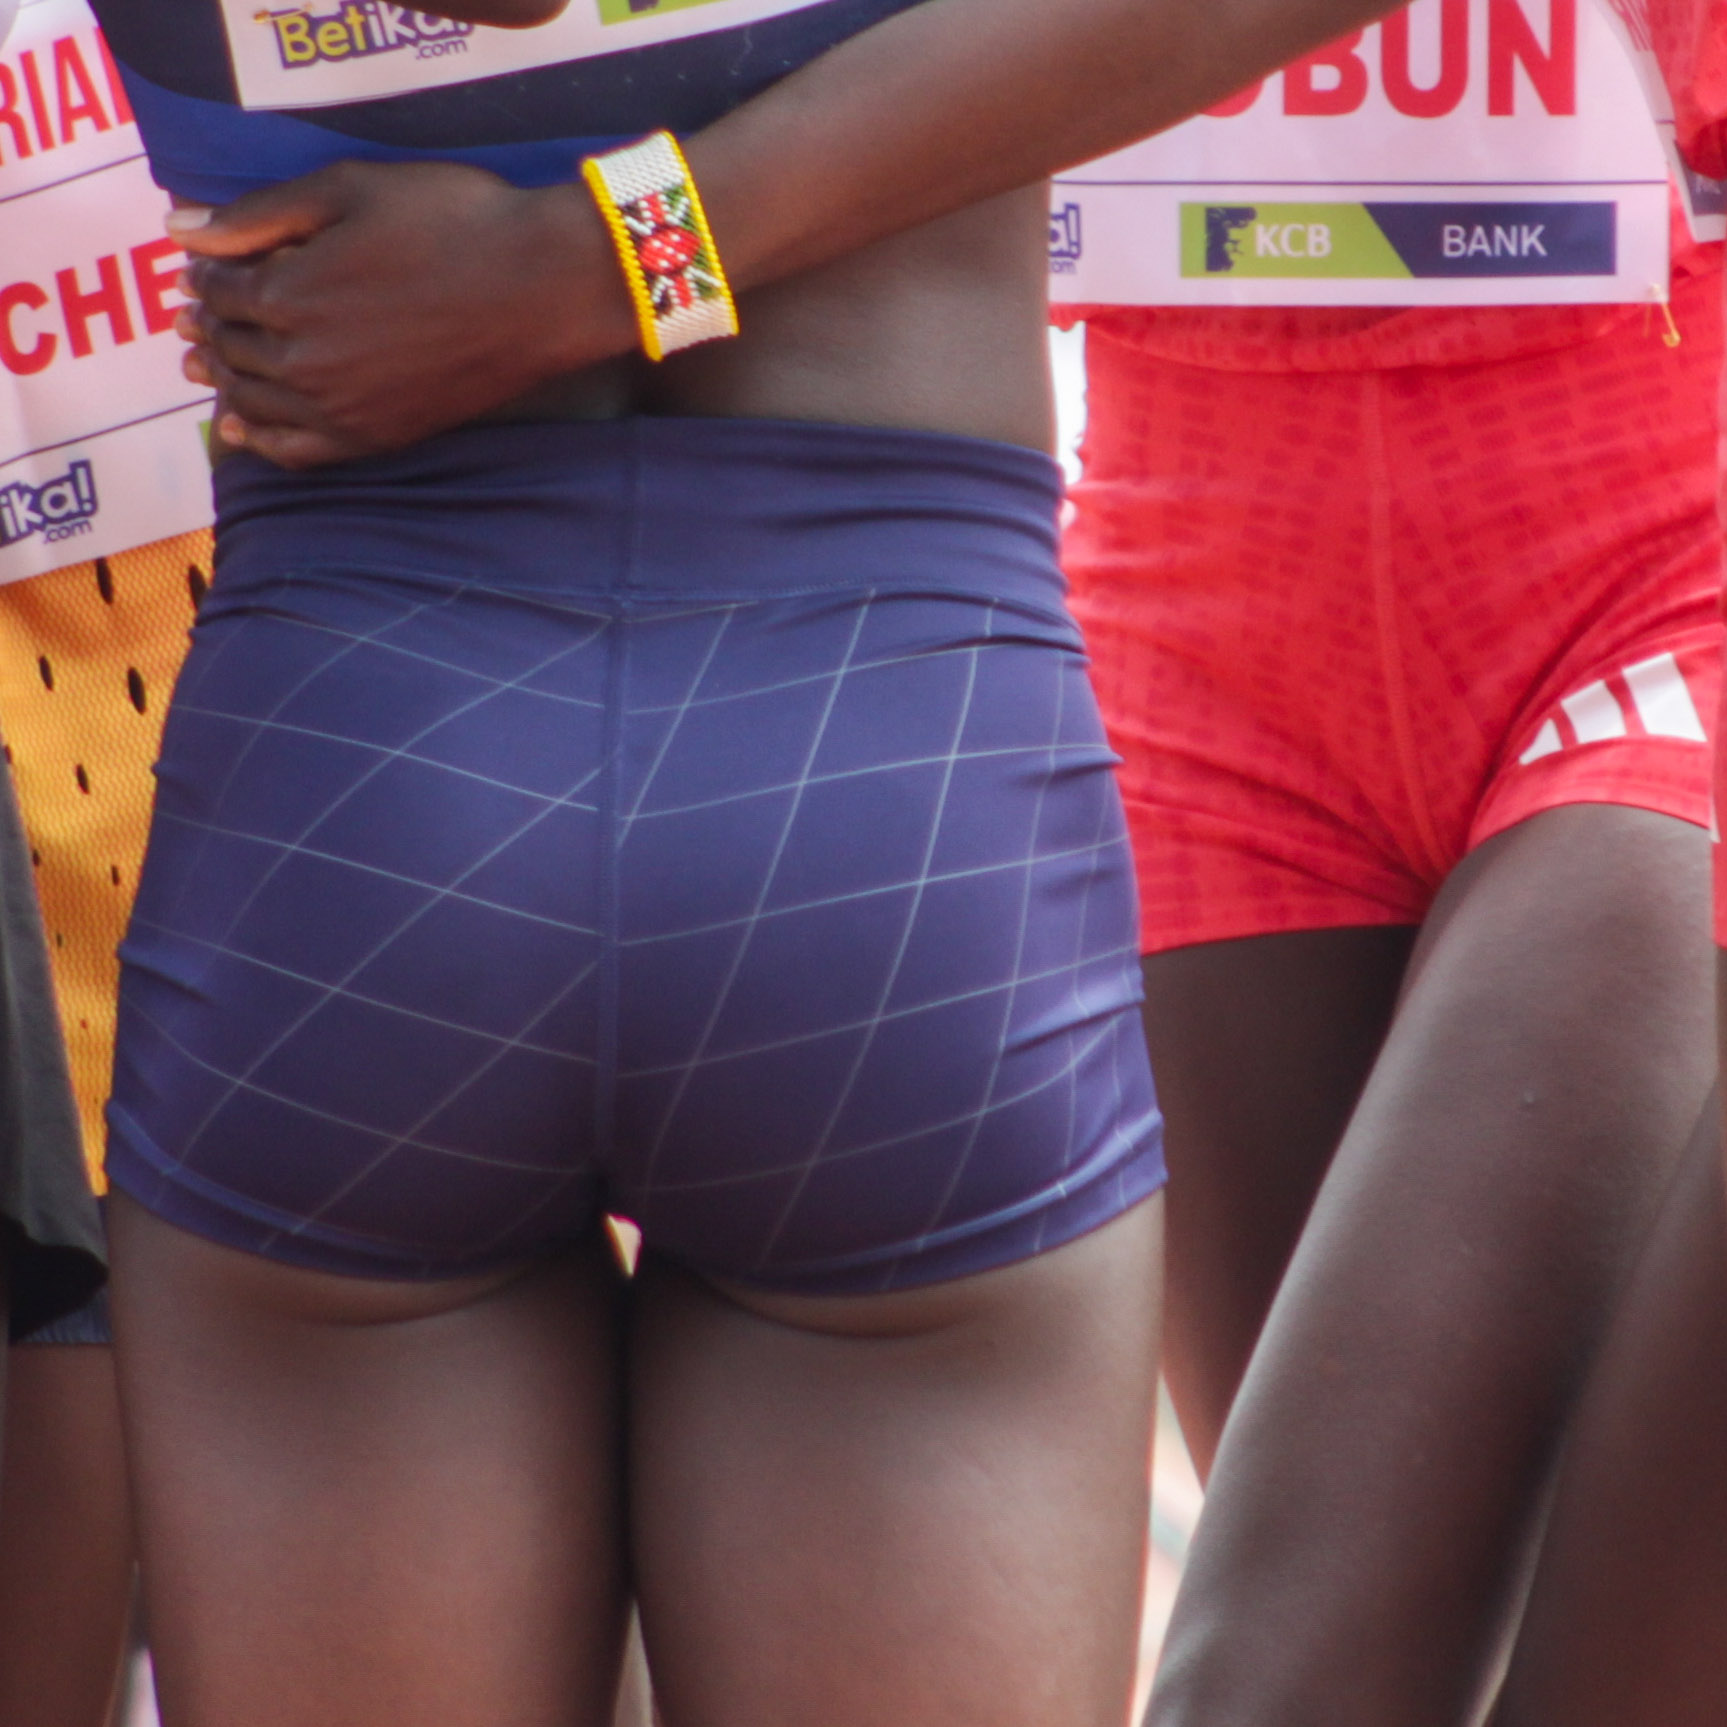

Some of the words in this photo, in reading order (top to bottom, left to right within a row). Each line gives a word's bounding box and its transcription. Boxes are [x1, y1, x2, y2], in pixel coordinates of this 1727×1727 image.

[415, 38, 469, 61] .com
[1254, 223, 1333, 259] KCB
[1441, 224, 1549, 260] BANK
[43, 518, 92, 544] .com
